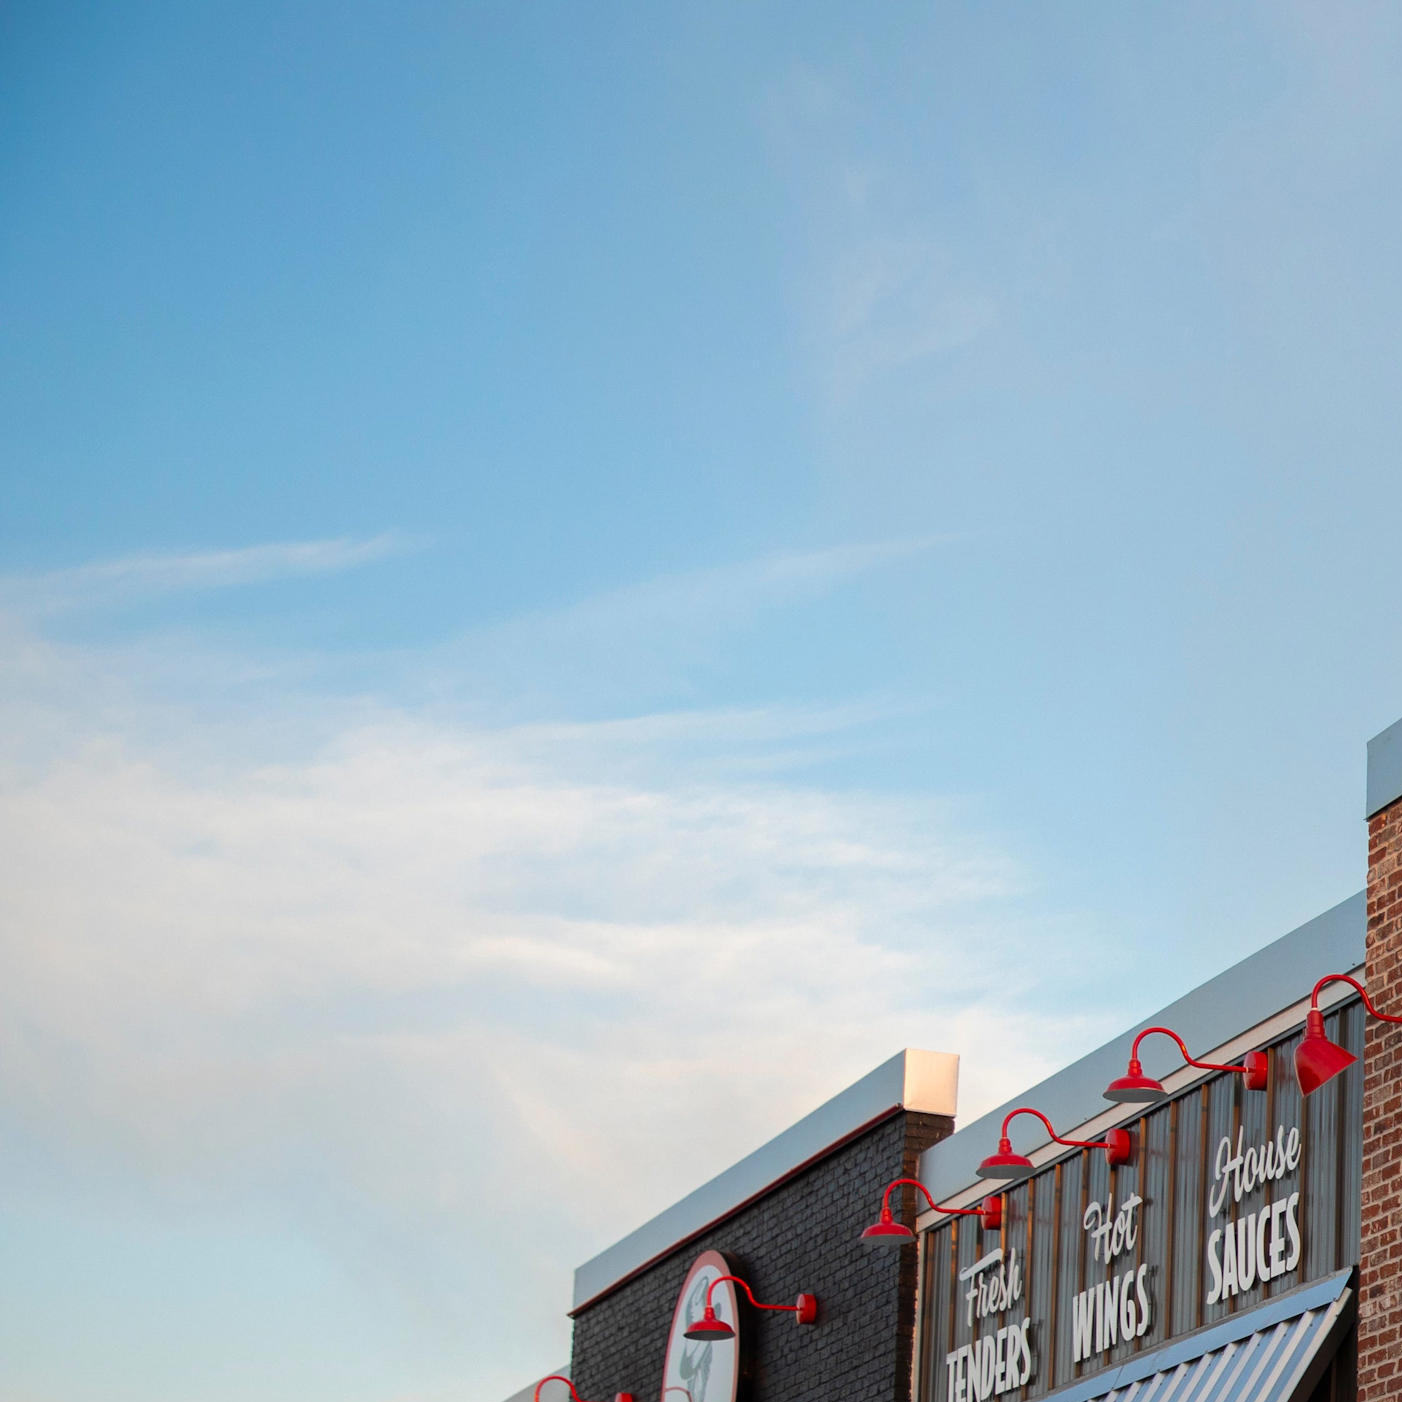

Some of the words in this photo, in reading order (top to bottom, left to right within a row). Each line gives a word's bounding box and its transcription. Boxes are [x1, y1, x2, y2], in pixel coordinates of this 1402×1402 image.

[1209, 1125, 1302, 1218] House
[1083, 1193, 1144, 1265] Hot
[1206, 1192, 1301, 1305] SAUCES
[959, 1247, 1023, 1327] Fresh
[1072, 1263, 1149, 1363] WINGS
